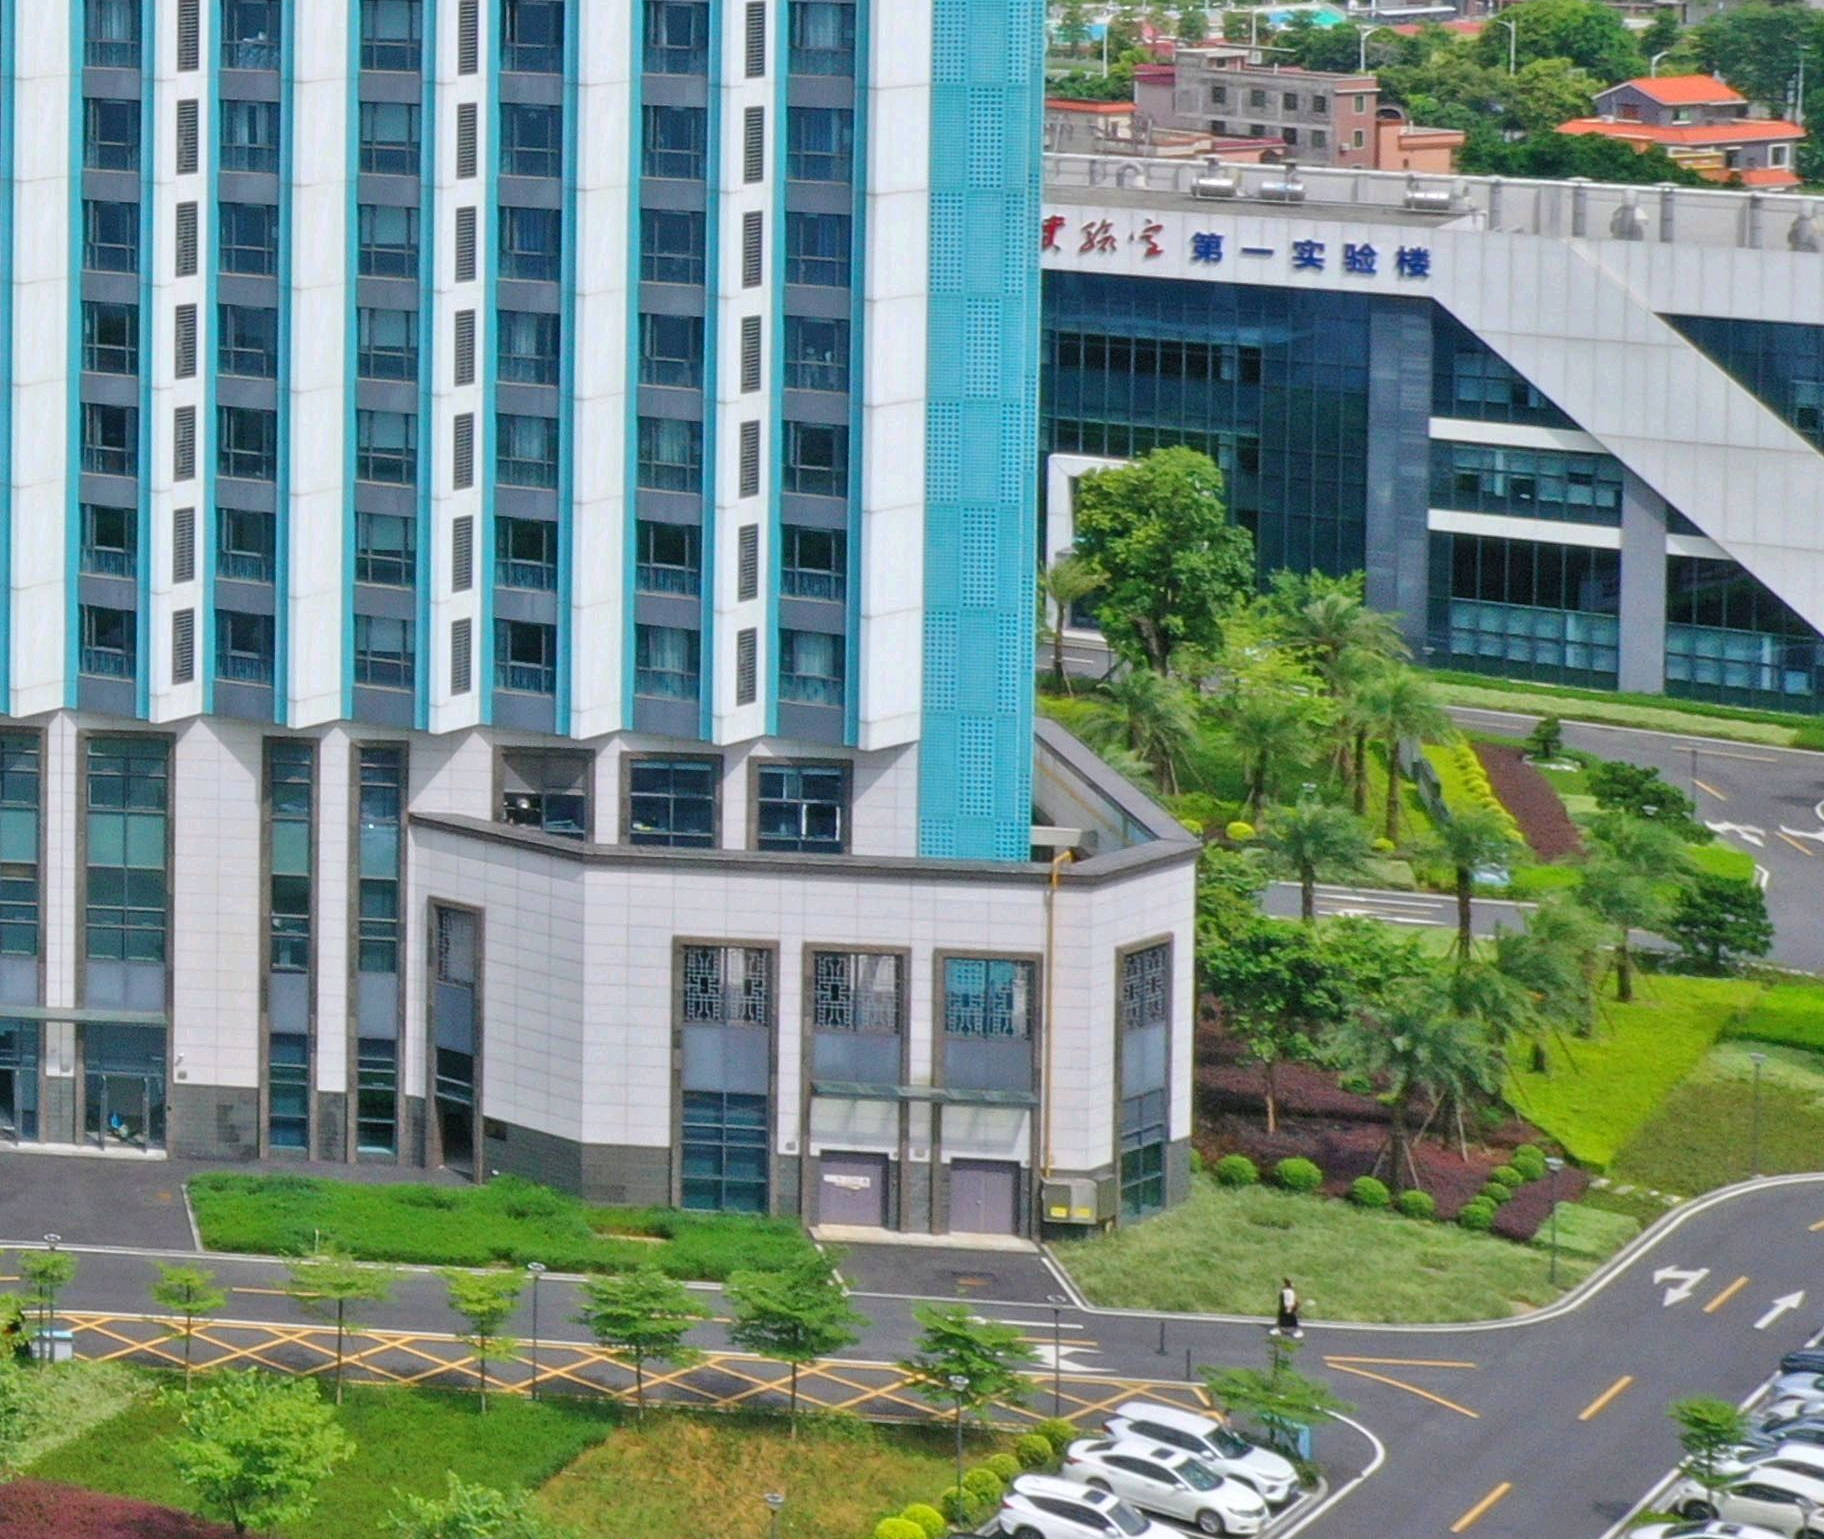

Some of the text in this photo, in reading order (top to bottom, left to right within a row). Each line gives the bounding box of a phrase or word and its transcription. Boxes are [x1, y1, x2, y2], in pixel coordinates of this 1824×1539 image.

[1192, 232, 1431, 279] 第一实验楼
